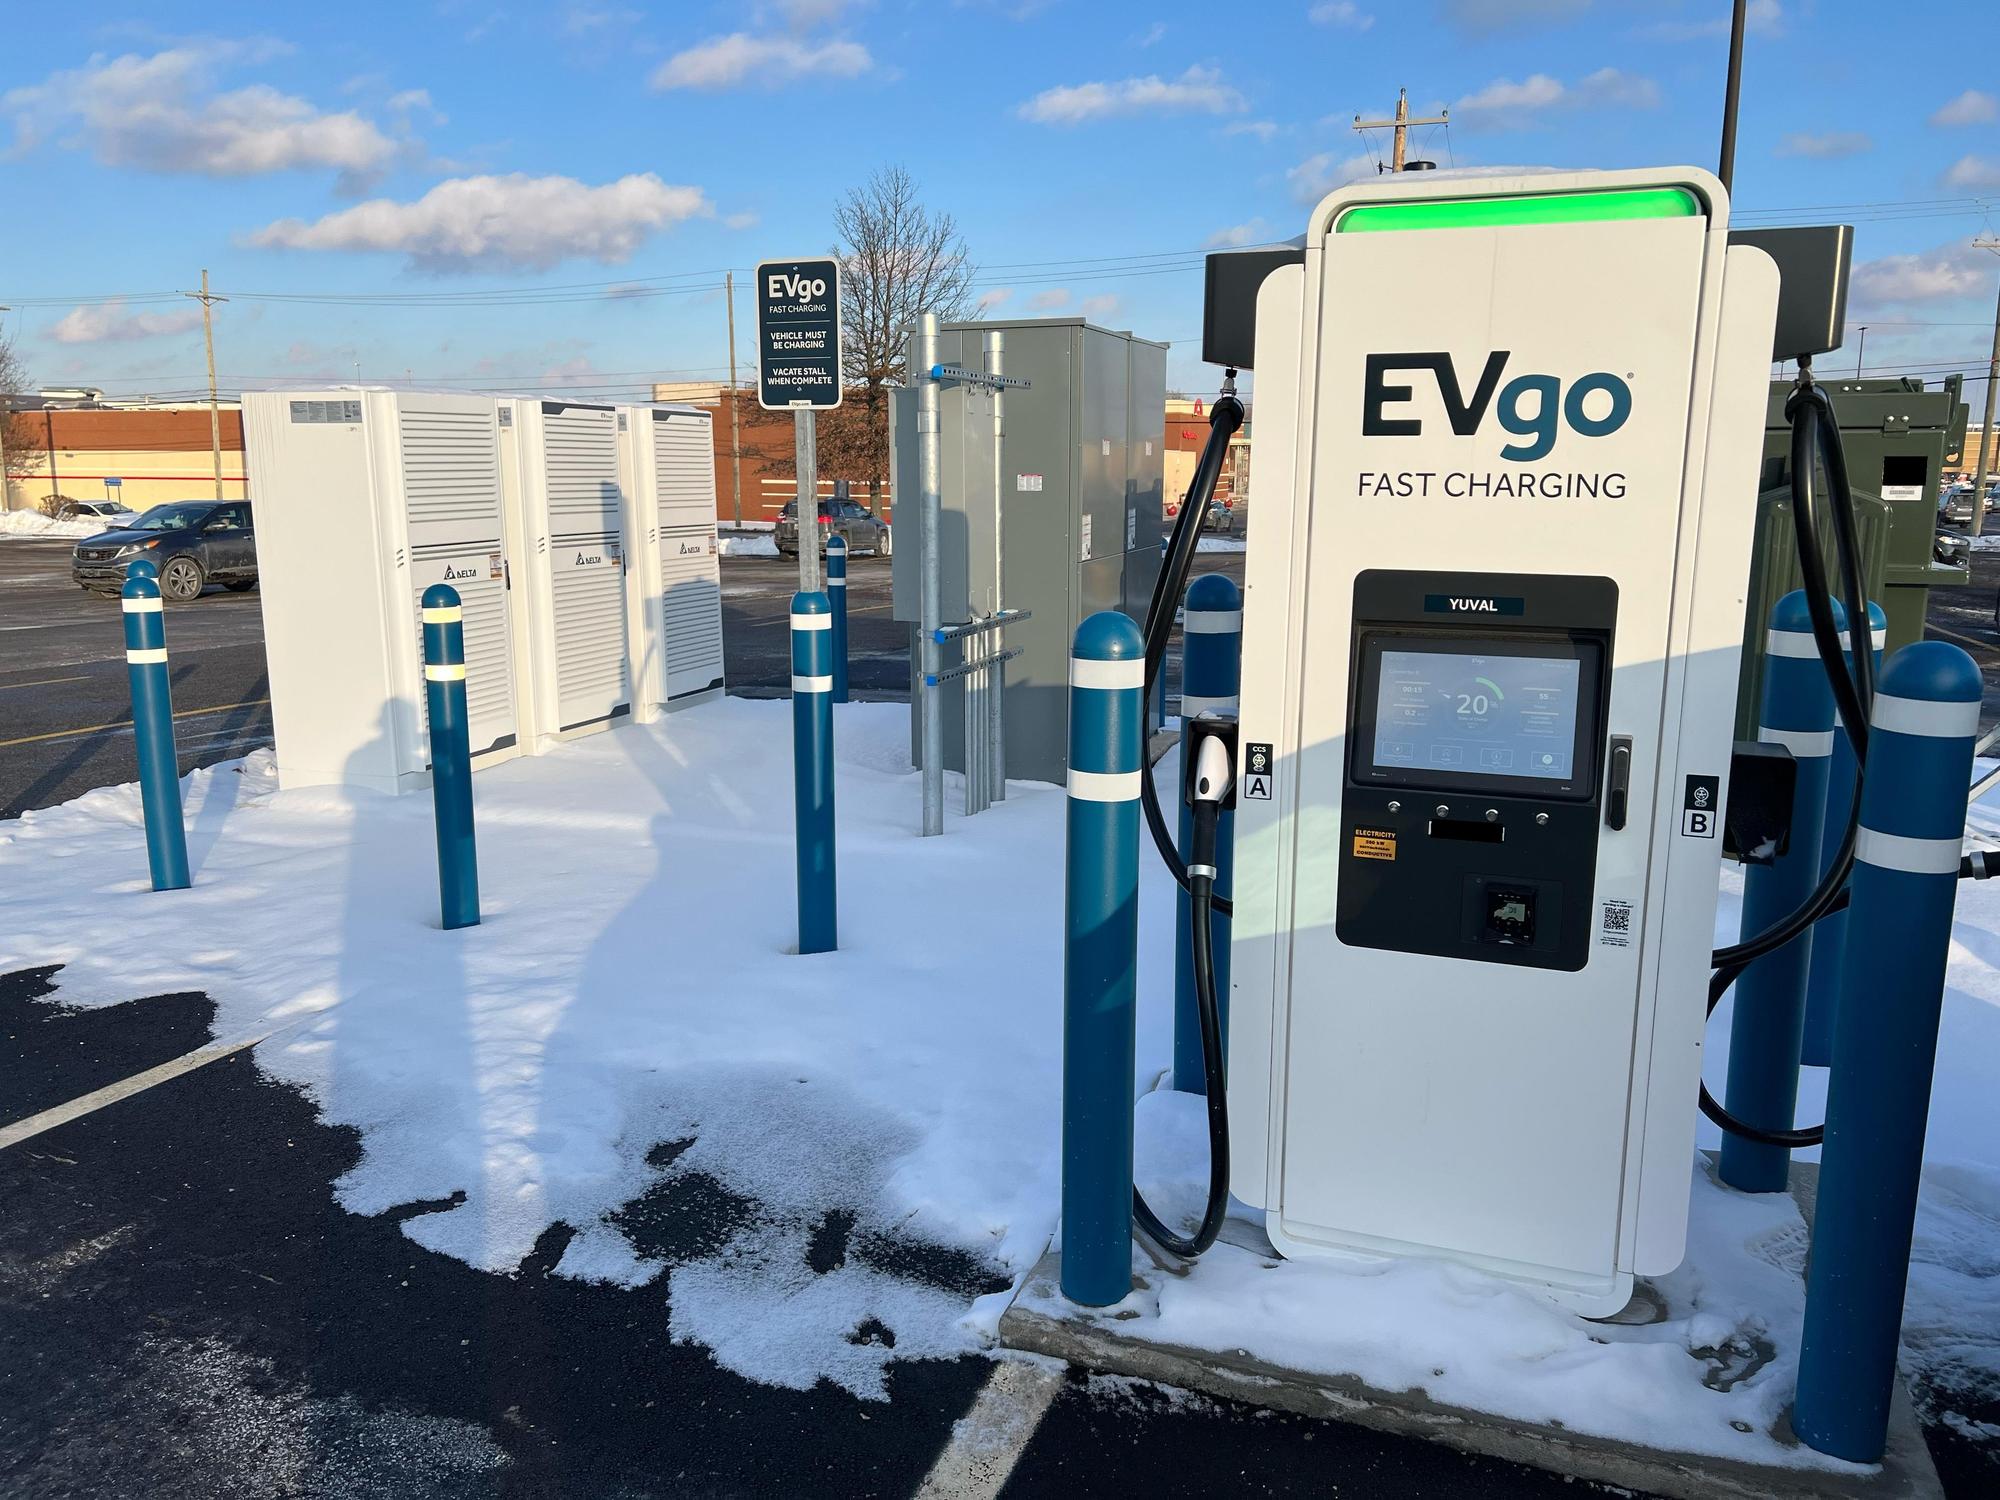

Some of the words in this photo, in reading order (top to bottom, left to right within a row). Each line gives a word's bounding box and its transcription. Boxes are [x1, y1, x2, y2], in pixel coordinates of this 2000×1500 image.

[768, 274, 826, 303] EVgo
[769, 306, 787, 314] FAST
[787, 305, 827, 313] CHARGING
[770, 332, 803, 340] VEHICLE
[805, 331, 827, 339] MUST
[773, 342, 783, 350] BE
[784, 341, 825, 349] CHARGING
[772, 368, 802, 376] VACATE
[803, 367, 827, 375] STALL
[767, 377, 791, 385] WHEN
[791, 376, 833, 385] COMPLETE
[1362, 350, 1632, 462] EVgo
[1358, 472, 1437, 497] FAST
[1443, 472, 1627, 498] CHARGING
[456, 568, 477, 579] DELTA
[1449, 598, 1498, 612] YUVAL
[1456, 694, 1488, 715] 20
[1249, 777, 1267, 796] A
[1690, 812, 1707, 833] B
[1355, 829, 1396, 838] ELECTRICITY
